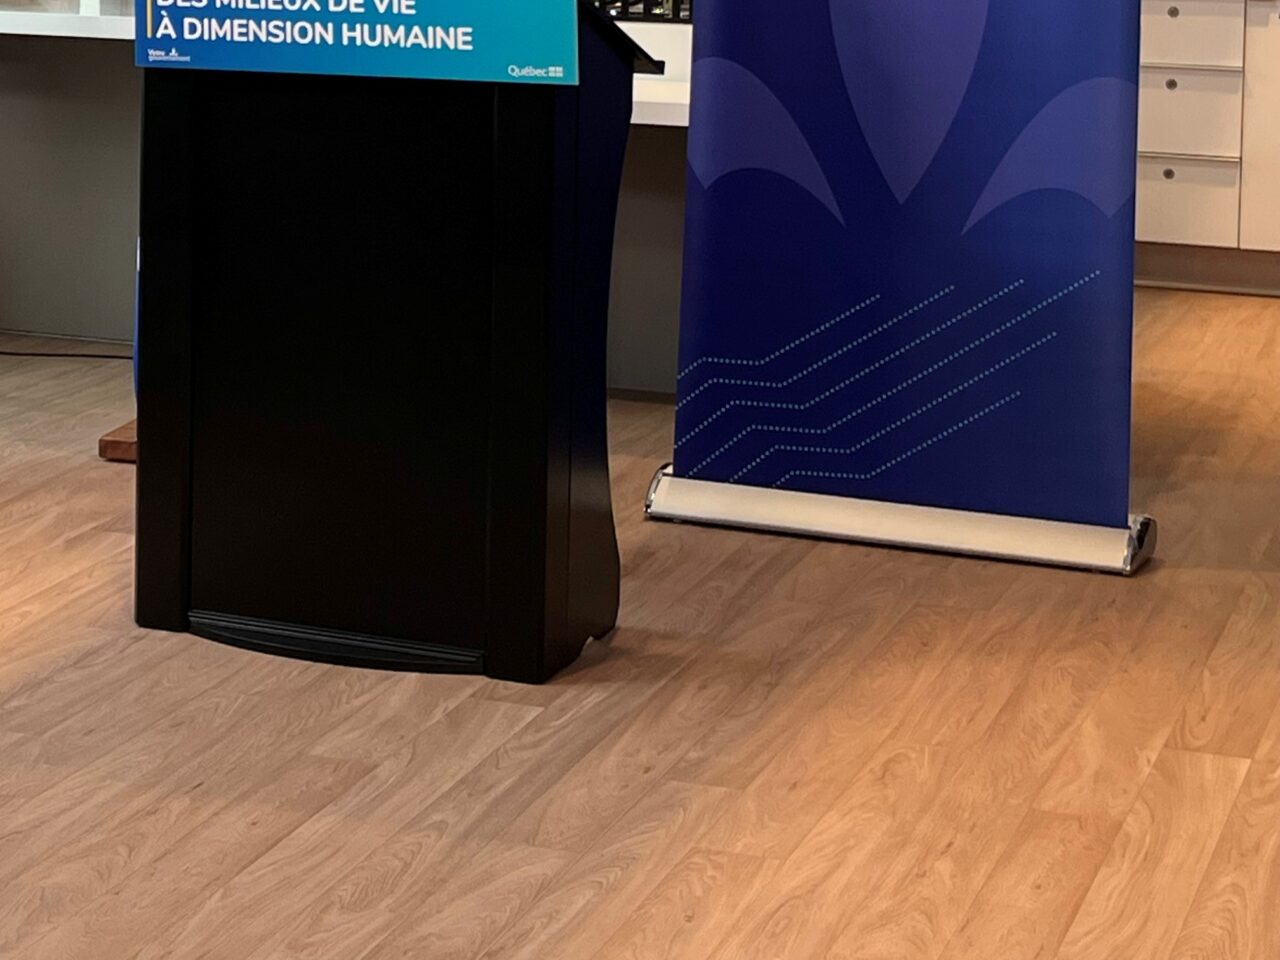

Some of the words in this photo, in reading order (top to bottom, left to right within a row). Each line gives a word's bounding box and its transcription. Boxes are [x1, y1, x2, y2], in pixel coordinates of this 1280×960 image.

[155, 10, 178, 40] À
[182, 16, 334, 45] DIMENSION
[341, 22, 474, 51] HUMAINE
[507, 64, 548, 78] Québec
